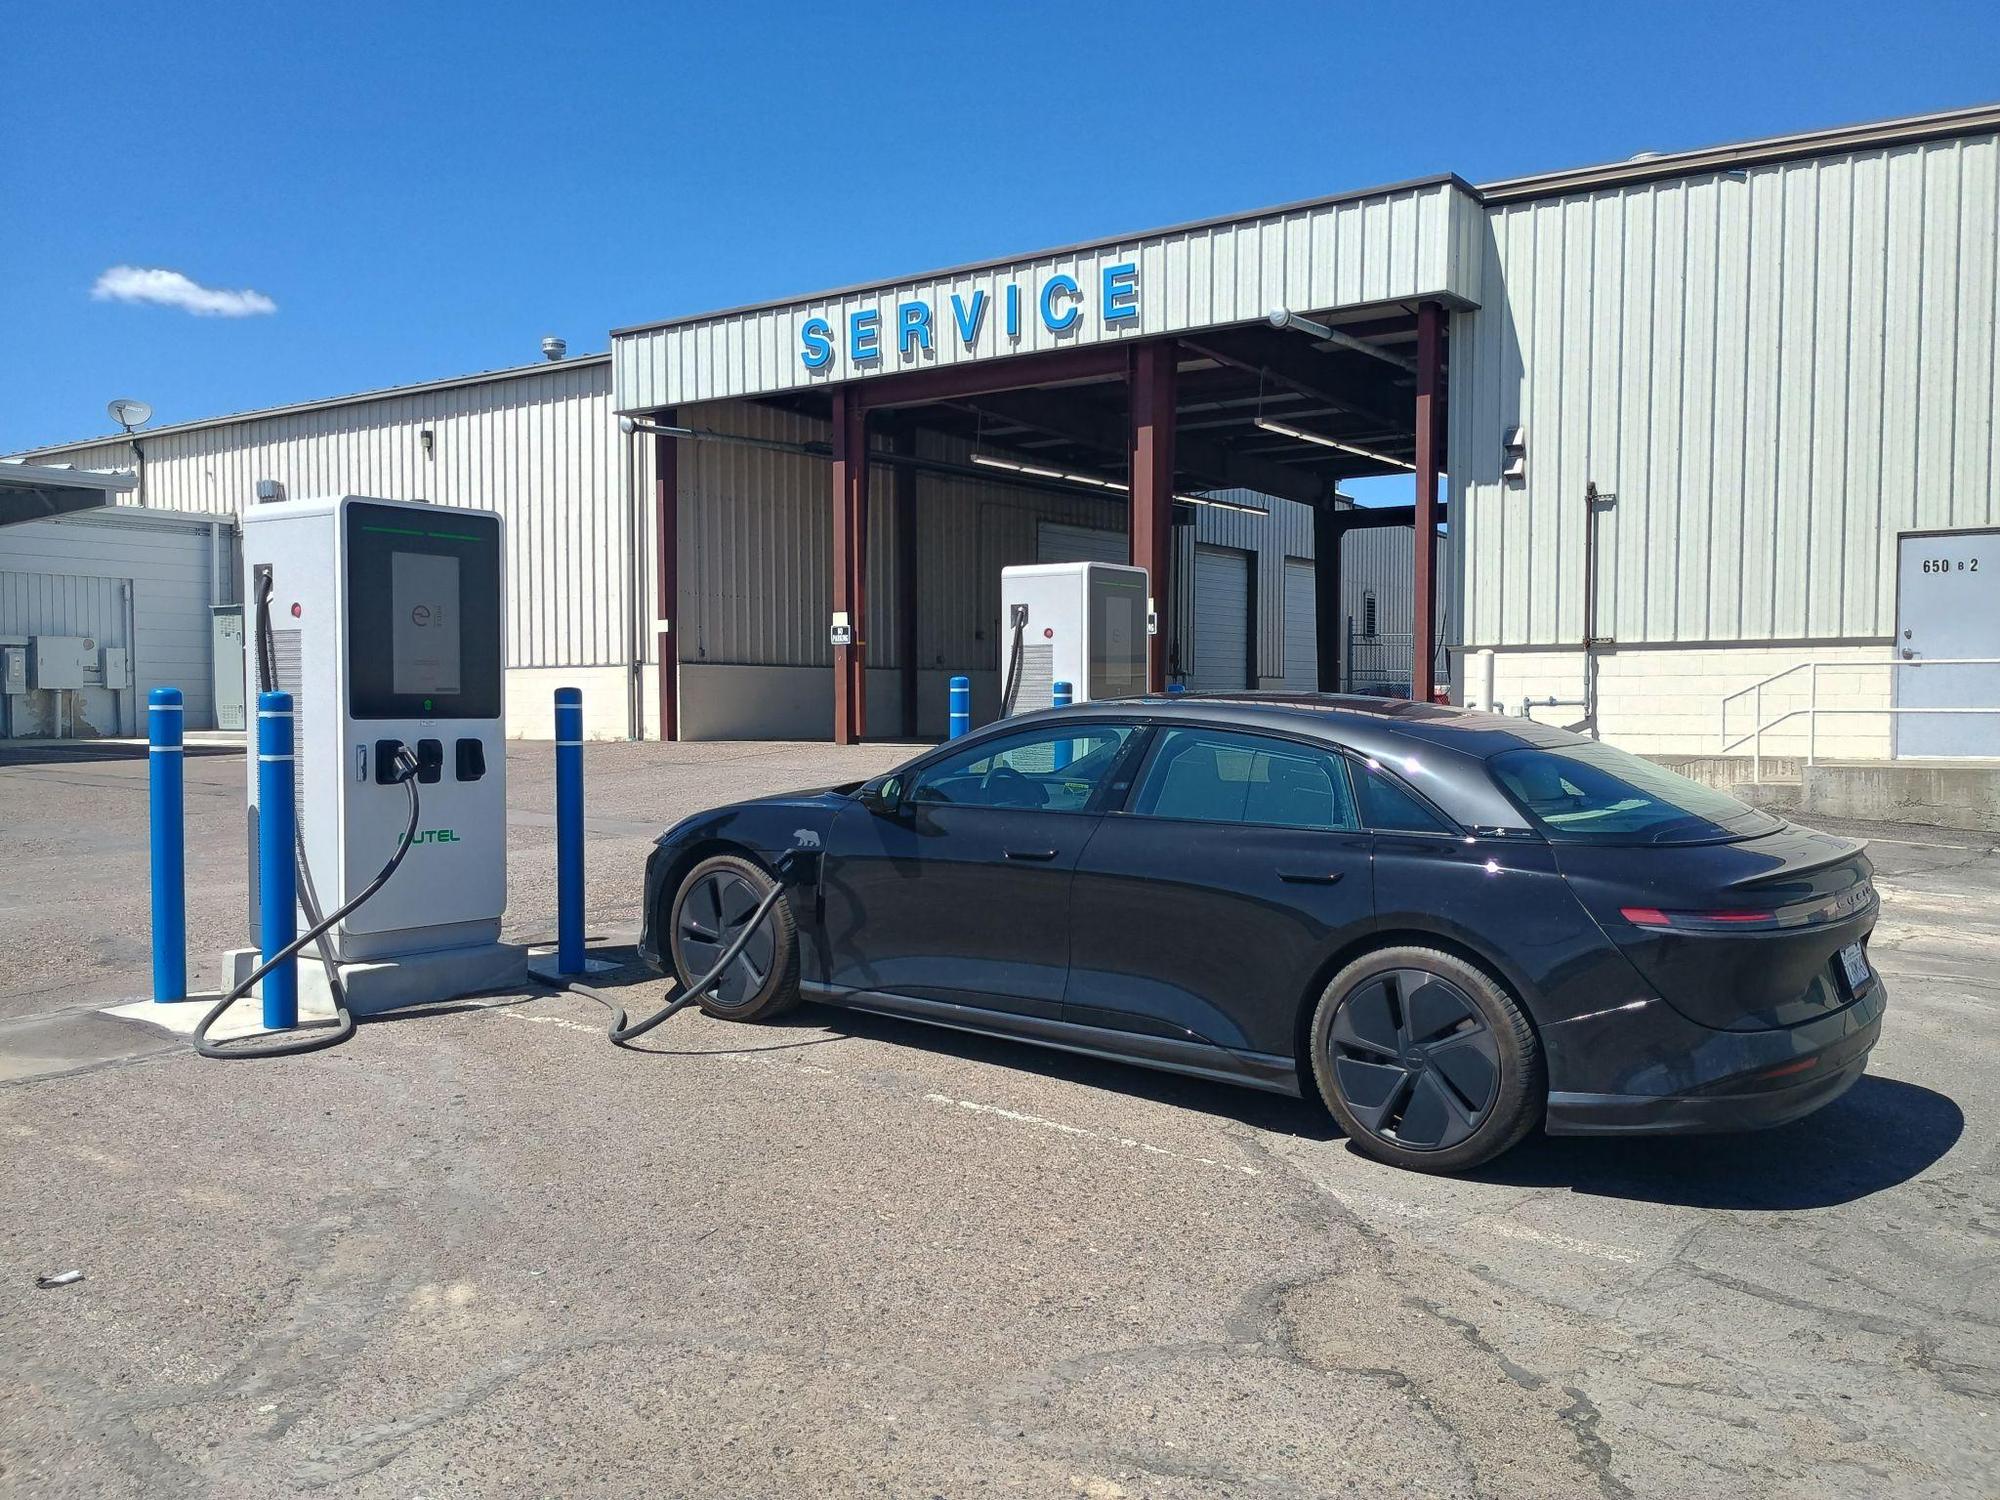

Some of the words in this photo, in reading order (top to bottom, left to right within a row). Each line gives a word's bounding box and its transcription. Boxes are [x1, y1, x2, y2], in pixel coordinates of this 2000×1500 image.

[800, 262, 1138, 369] SERVICE
[1923, 559, 1949, 573] 650
[1970, 558, 1979, 572] 2
